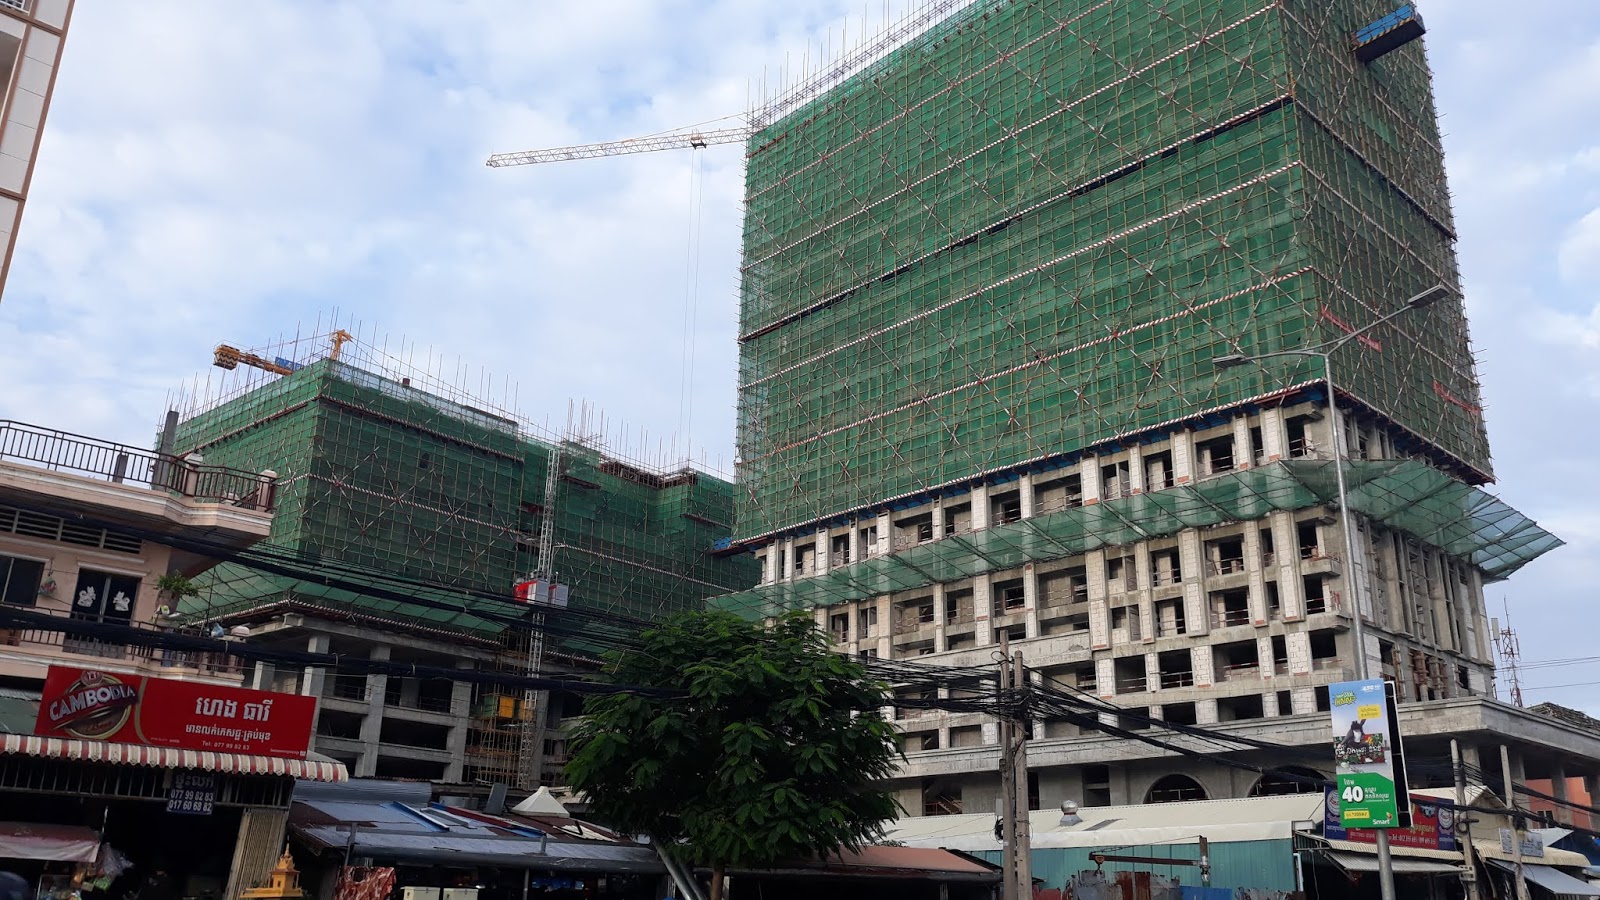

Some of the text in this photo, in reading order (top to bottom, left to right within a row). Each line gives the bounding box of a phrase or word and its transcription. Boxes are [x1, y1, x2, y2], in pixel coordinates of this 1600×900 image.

[49, 685, 135, 721] CAMBODIA
[195, 697, 238, 718] ហេង
[170, 789, 184, 799] 077
[185, 790, 194, 800] 99
[1341, 785, 1364, 802] 40
[168, 800, 182, 809] 017
[183, 801, 192, 810] 60
